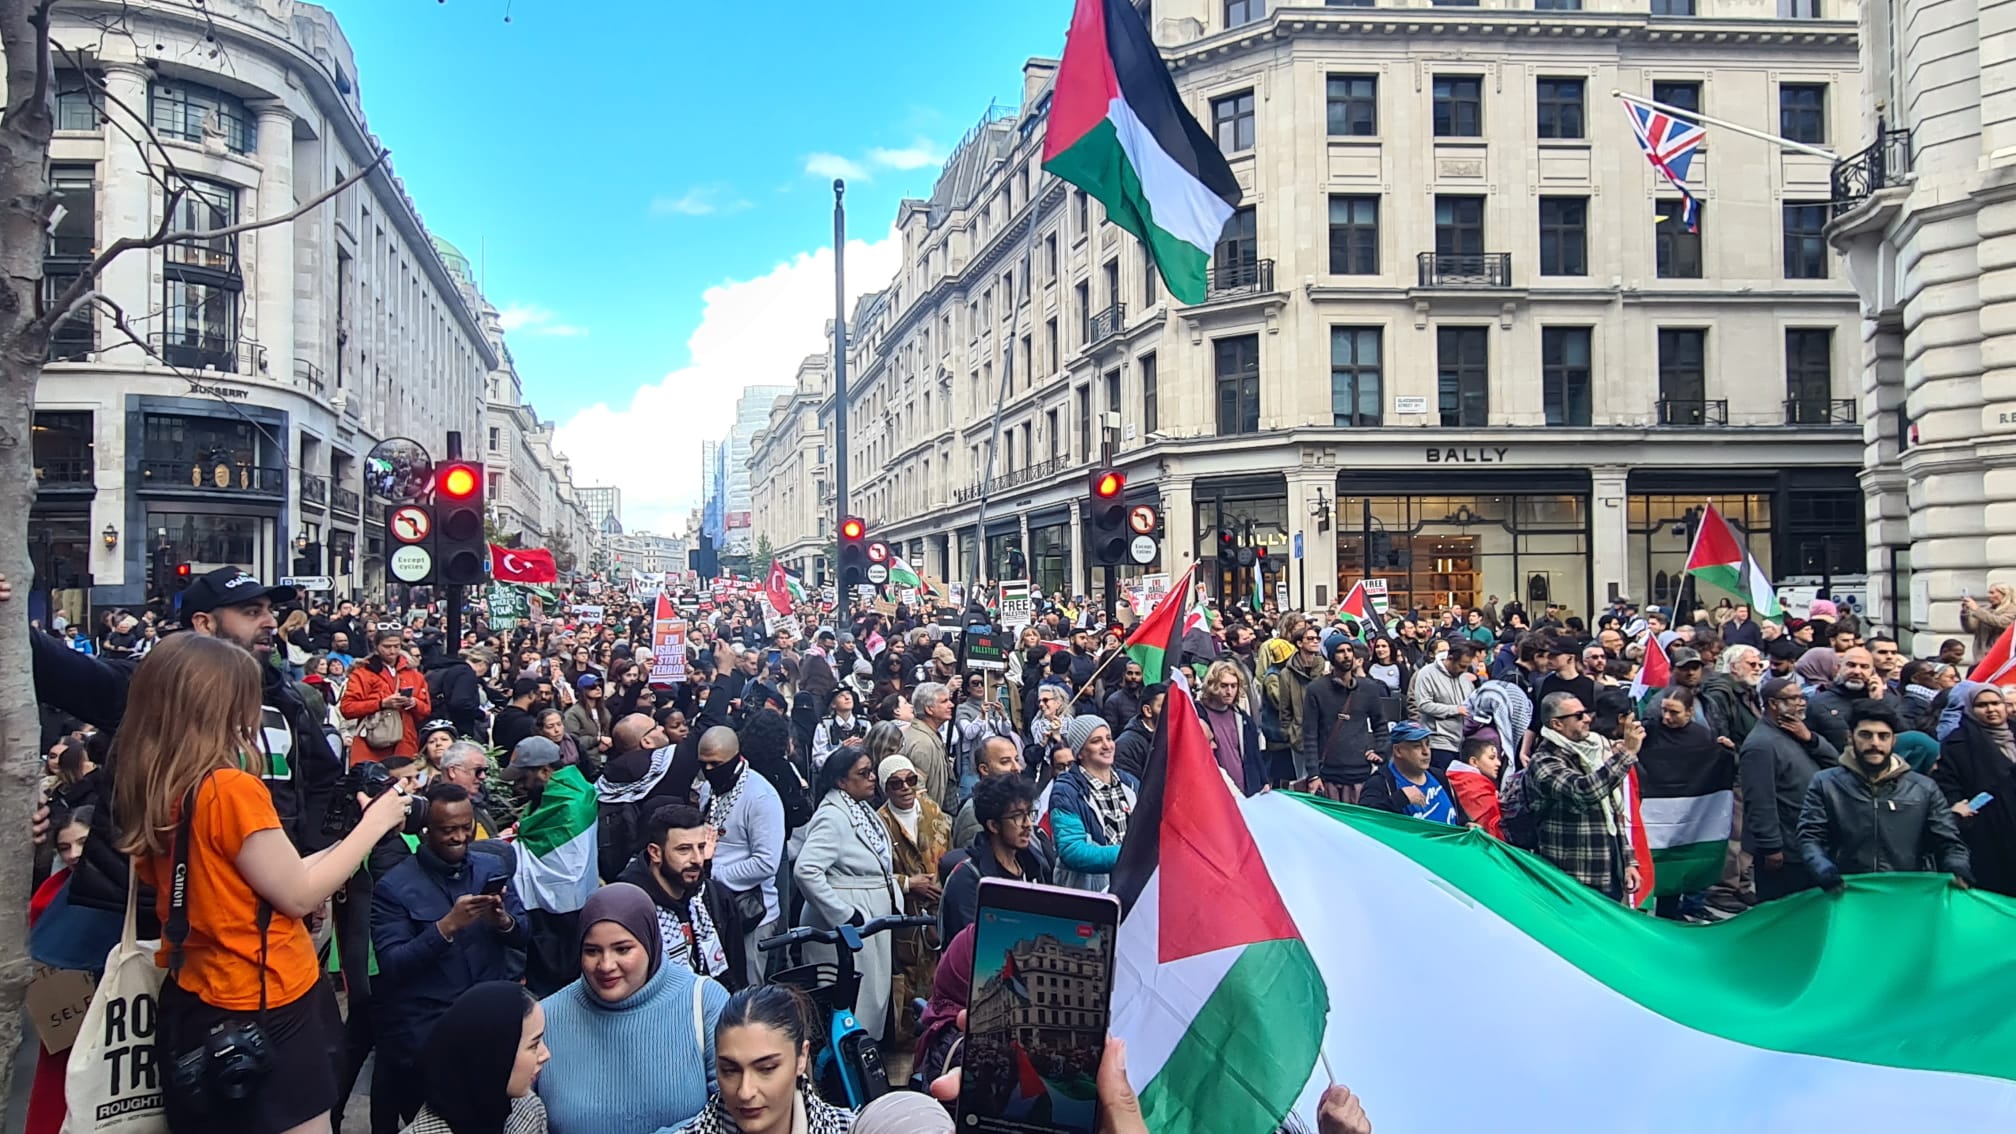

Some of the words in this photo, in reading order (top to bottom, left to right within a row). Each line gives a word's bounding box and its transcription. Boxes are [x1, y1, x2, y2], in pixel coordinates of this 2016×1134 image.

[1426, 447, 1509, 462] BALLY
[398, 556, 425, 564] Except
[1365, 580, 1383, 588] FREE
[491, 604, 514, 616] YOUR
[1002, 599, 1029, 611] FREE
[971, 645, 999, 655] PALESTINE
[657, 655, 683, 665] STATE
[652, 665, 685, 675] TERROR
[172, 863, 187, 908] Canon
